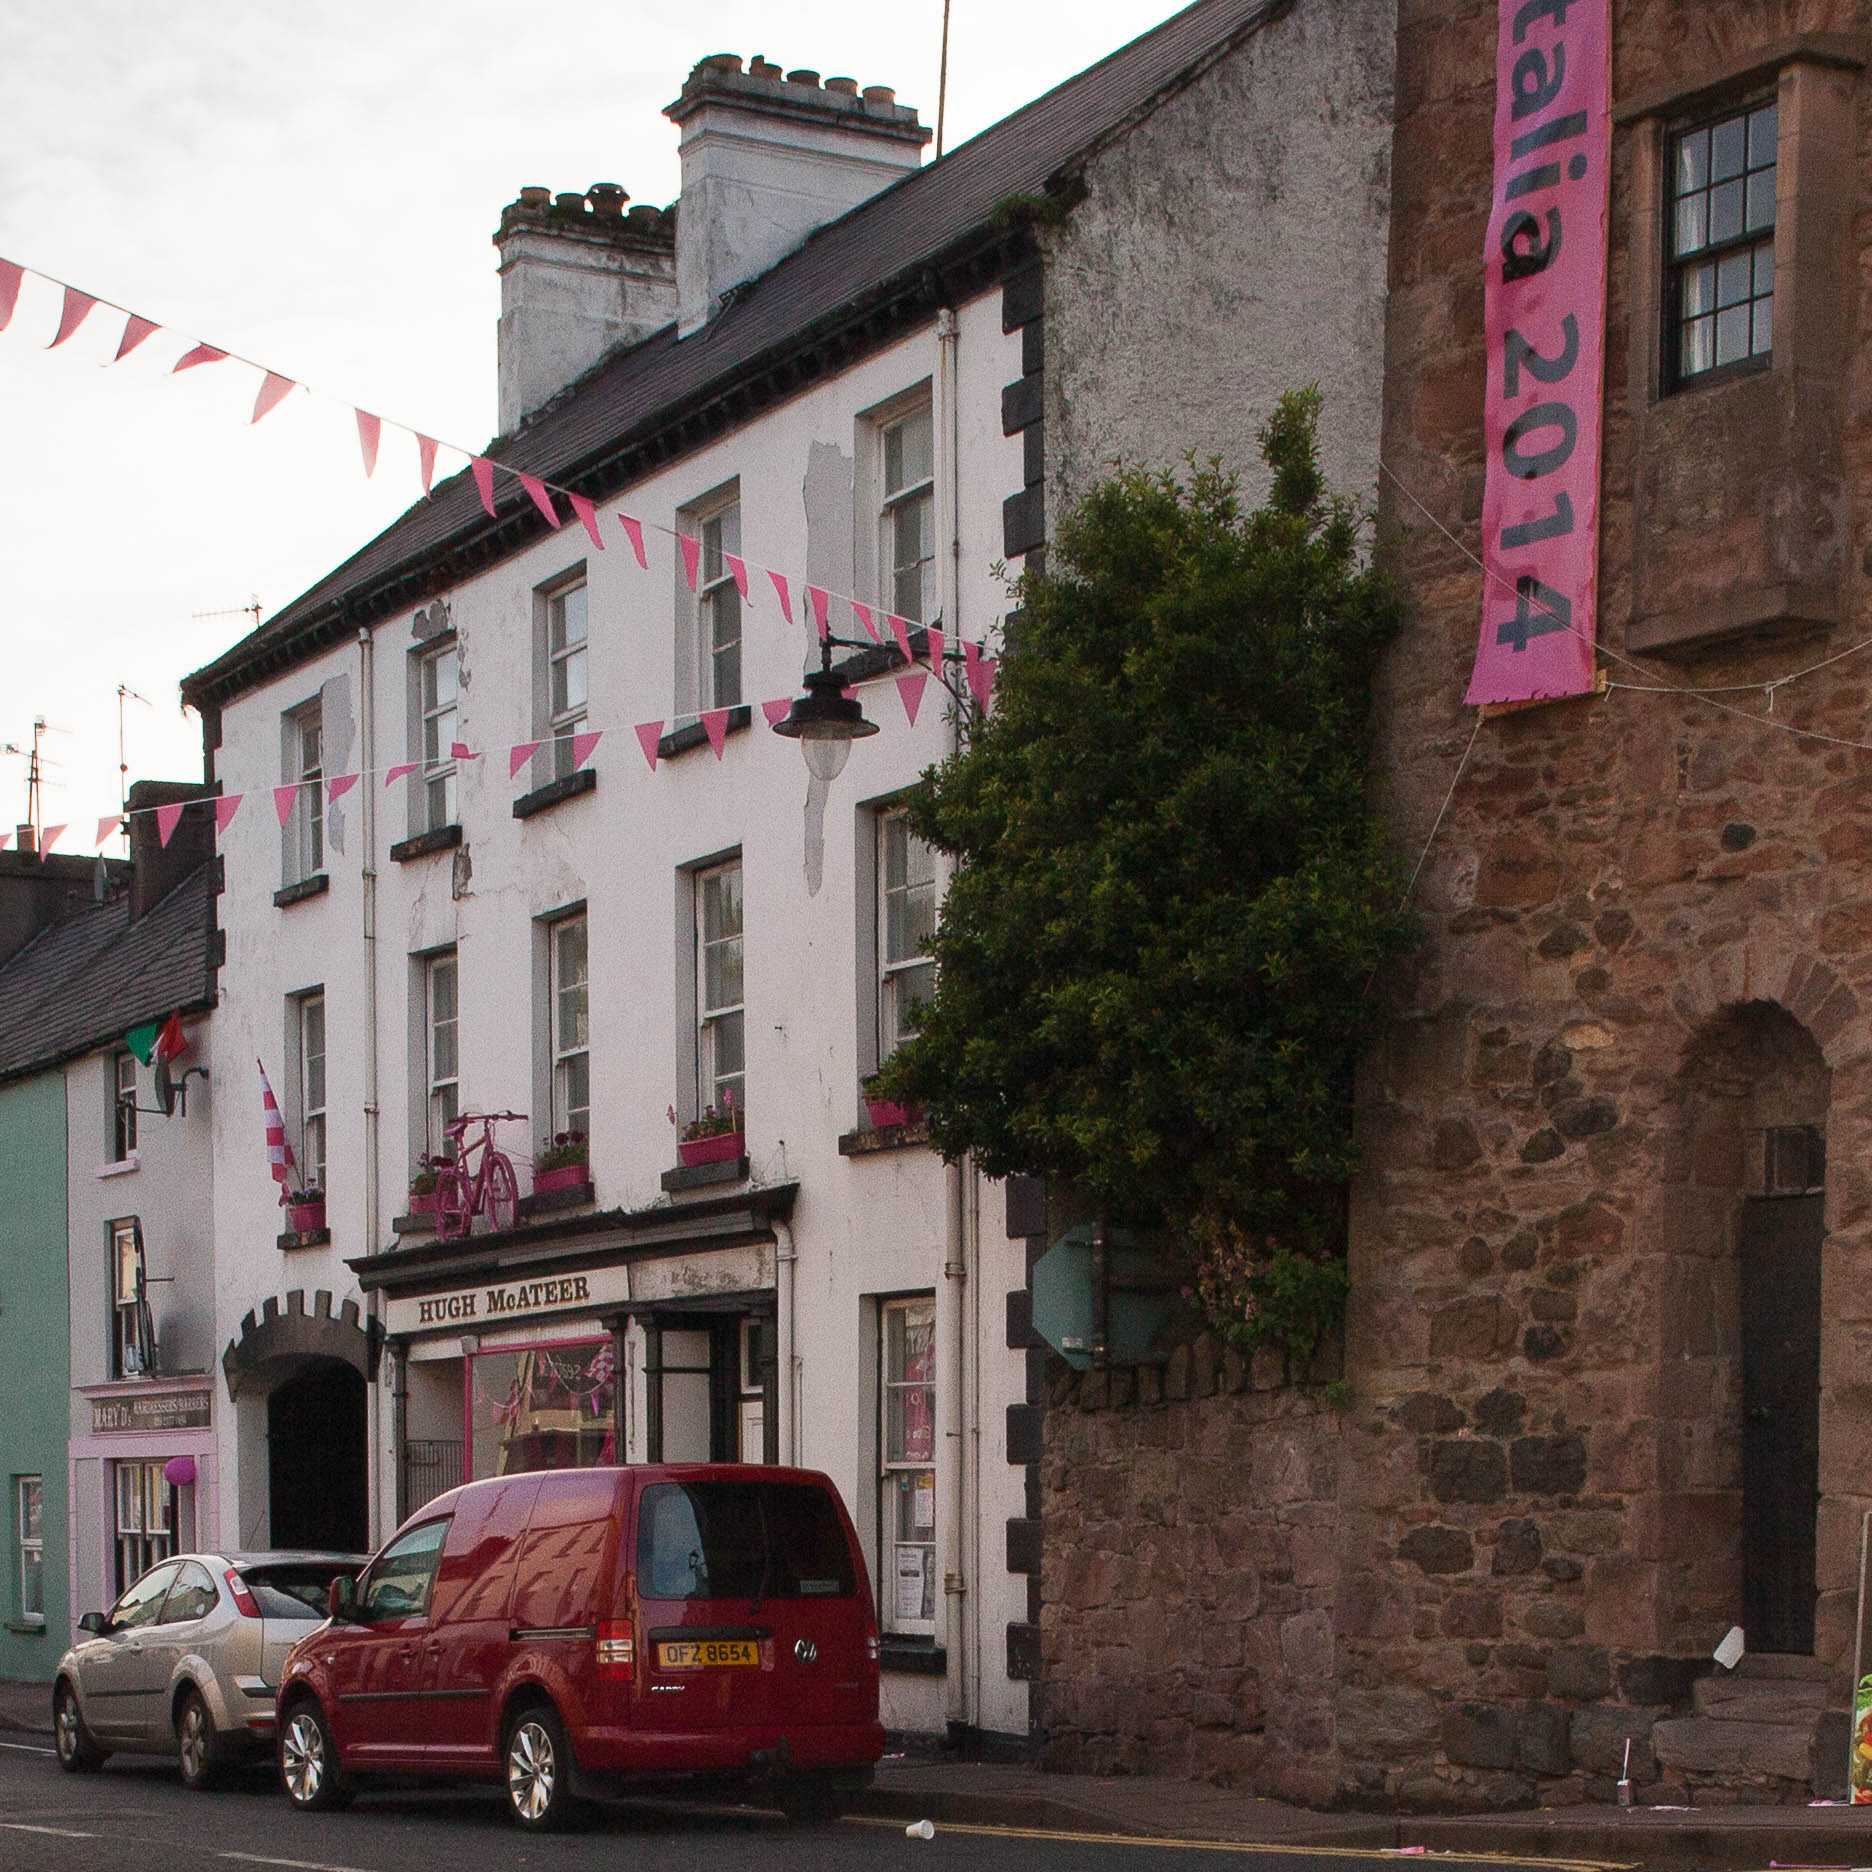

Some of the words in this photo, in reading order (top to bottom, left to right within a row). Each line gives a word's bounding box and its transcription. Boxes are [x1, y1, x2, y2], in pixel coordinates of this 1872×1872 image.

[1493, 312, 1582, 656] 2014
[418, 1293, 476, 1324] HUGH
[487, 1275, 591, 1313] McATEER
[94, 1405, 118, 1428] MARY
[666, 1645, 702, 1664] OFZ
[707, 1642, 751, 1662] 8654
